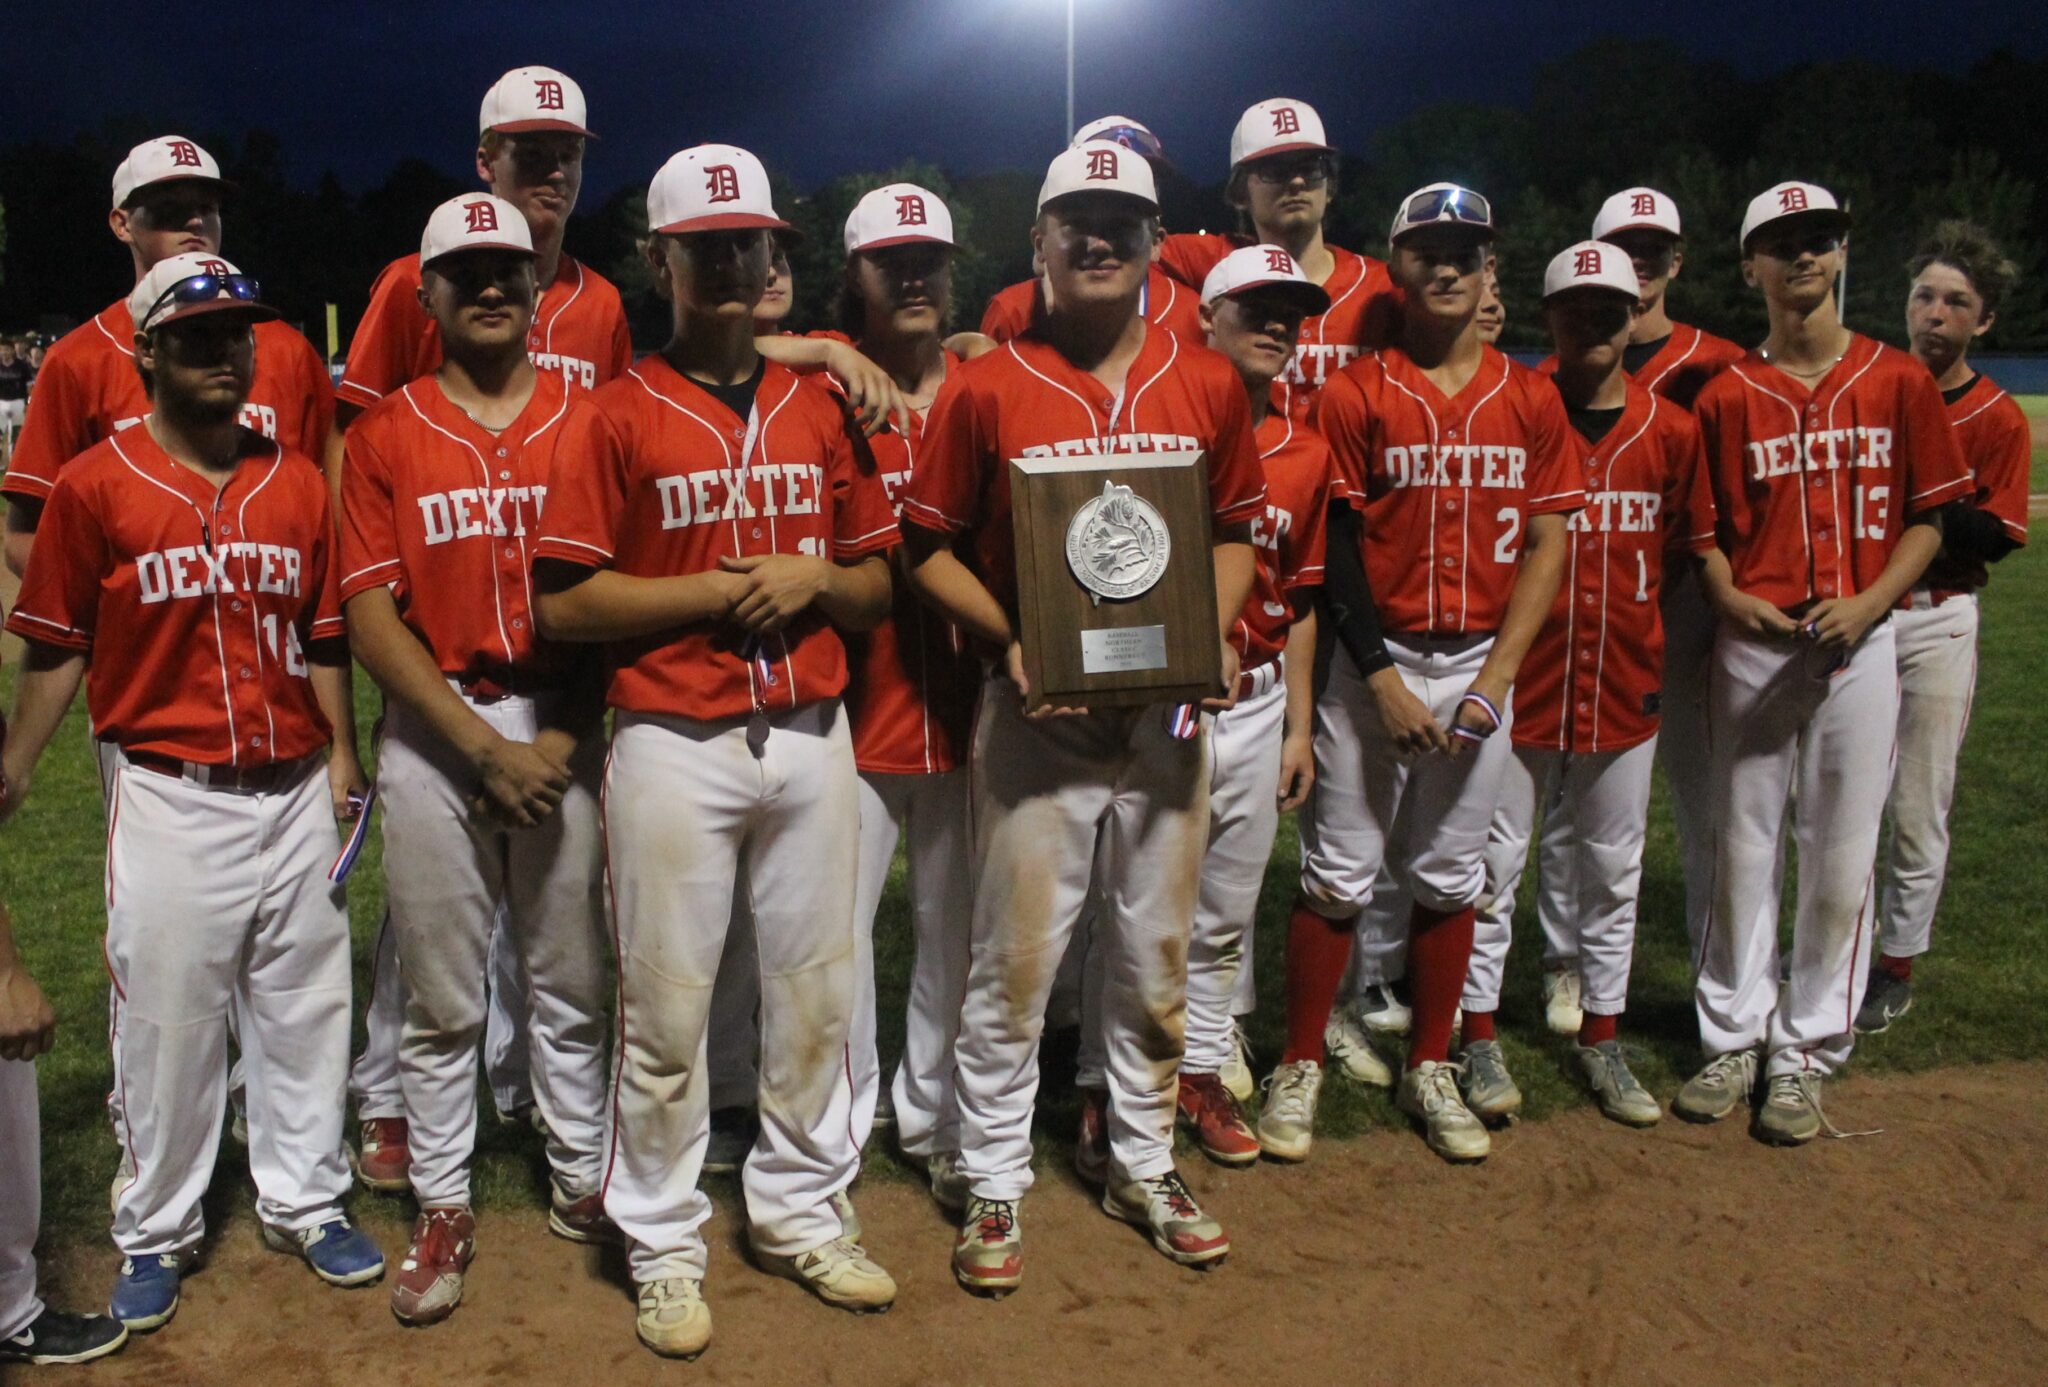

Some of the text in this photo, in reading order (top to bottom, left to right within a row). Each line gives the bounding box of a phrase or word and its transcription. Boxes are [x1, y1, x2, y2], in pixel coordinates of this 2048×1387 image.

[534, 80, 564, 110] D
[1270, 107, 1300, 136] D
[166, 140, 201, 167] D
[1086, 149, 1118, 180] D
[703, 163, 740, 204] D
[464, 200, 498, 233] D
[895, 194, 927, 226] D
[1630, 193, 1656, 216] D
[1777, 187, 1808, 214] D
[1264, 248, 1293, 276] D
[1574, 248, 1602, 277] D
[1384, 444, 1527, 489] DEXTER
[1745, 426, 1893, 482] DEXTER
[1854, 485, 1891, 541] 13
[1494, 507, 1520, 563] 2
[135, 542, 300, 604] DEXTER
[1635, 550, 1648, 602] 1
